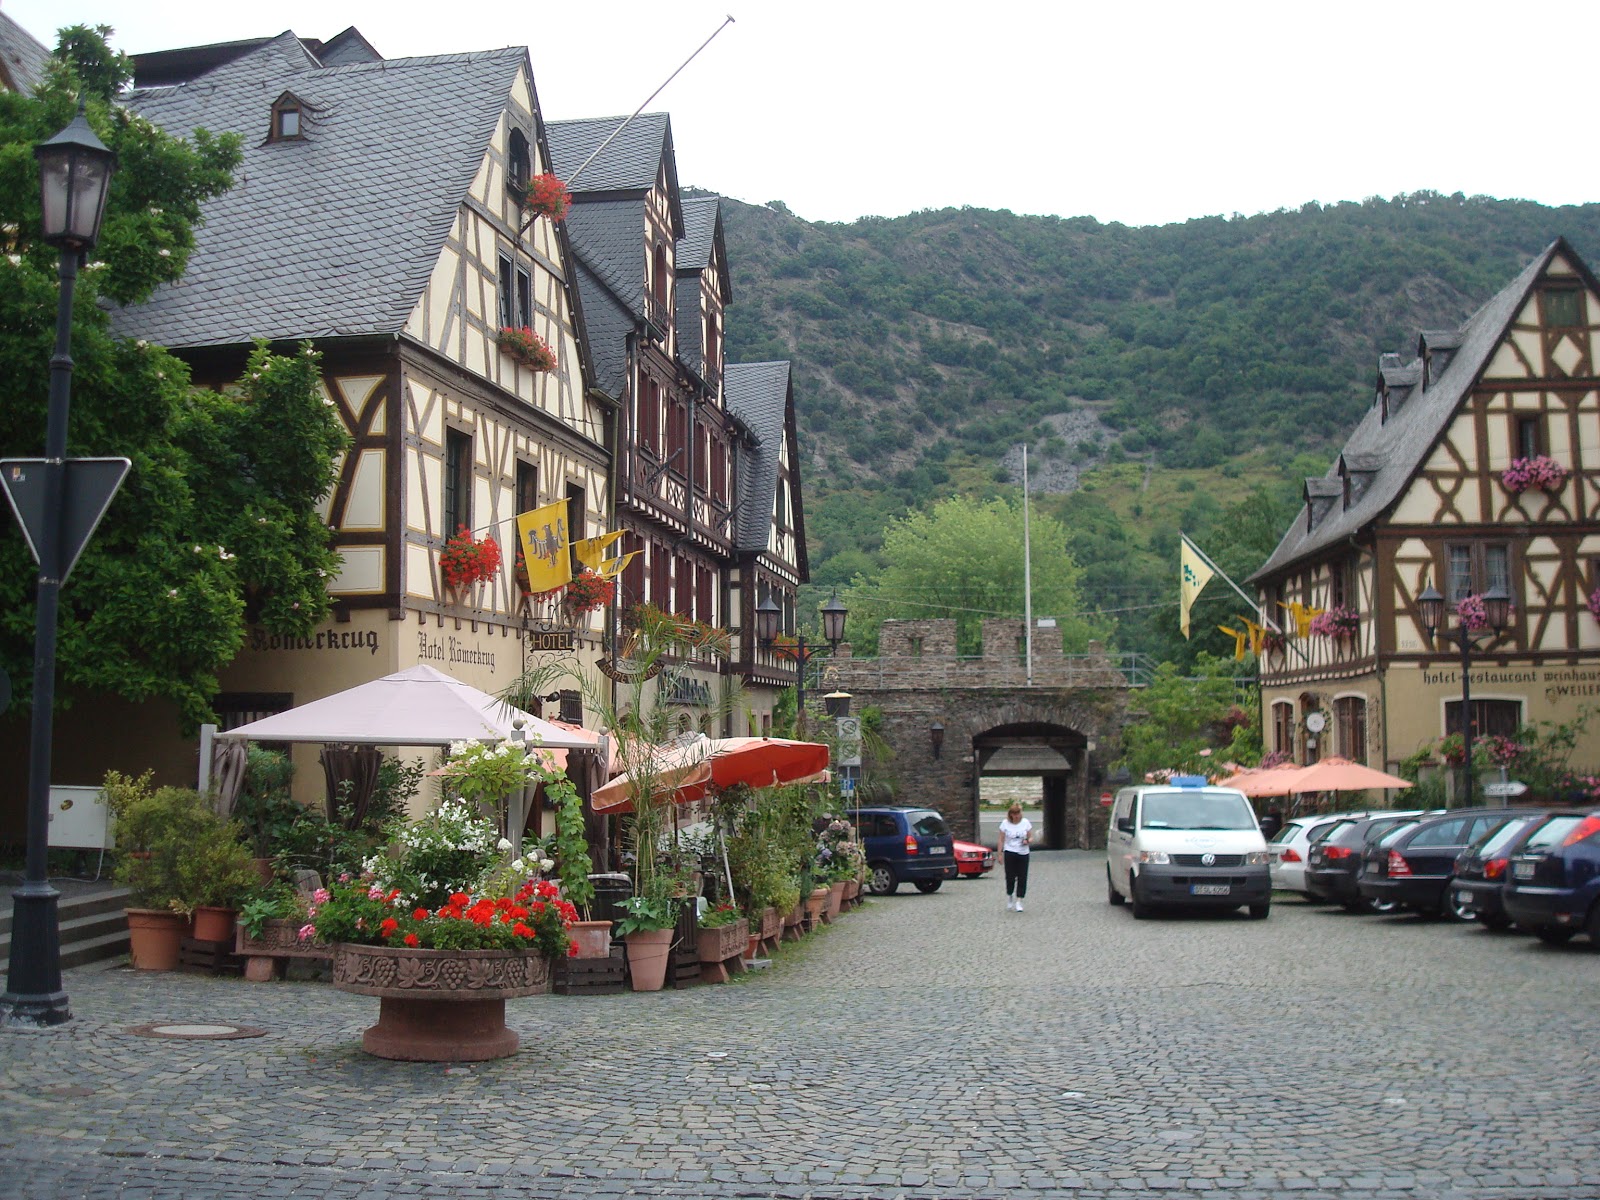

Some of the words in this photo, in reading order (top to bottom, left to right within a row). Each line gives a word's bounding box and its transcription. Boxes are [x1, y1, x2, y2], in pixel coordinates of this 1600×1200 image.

[531, 633, 573, 650] HOTEL
[417, 631, 445, 662] Hotel
[448, 636, 496, 673] Römerkrug
[1423, 670, 1537, 686] hotel-estaurant
